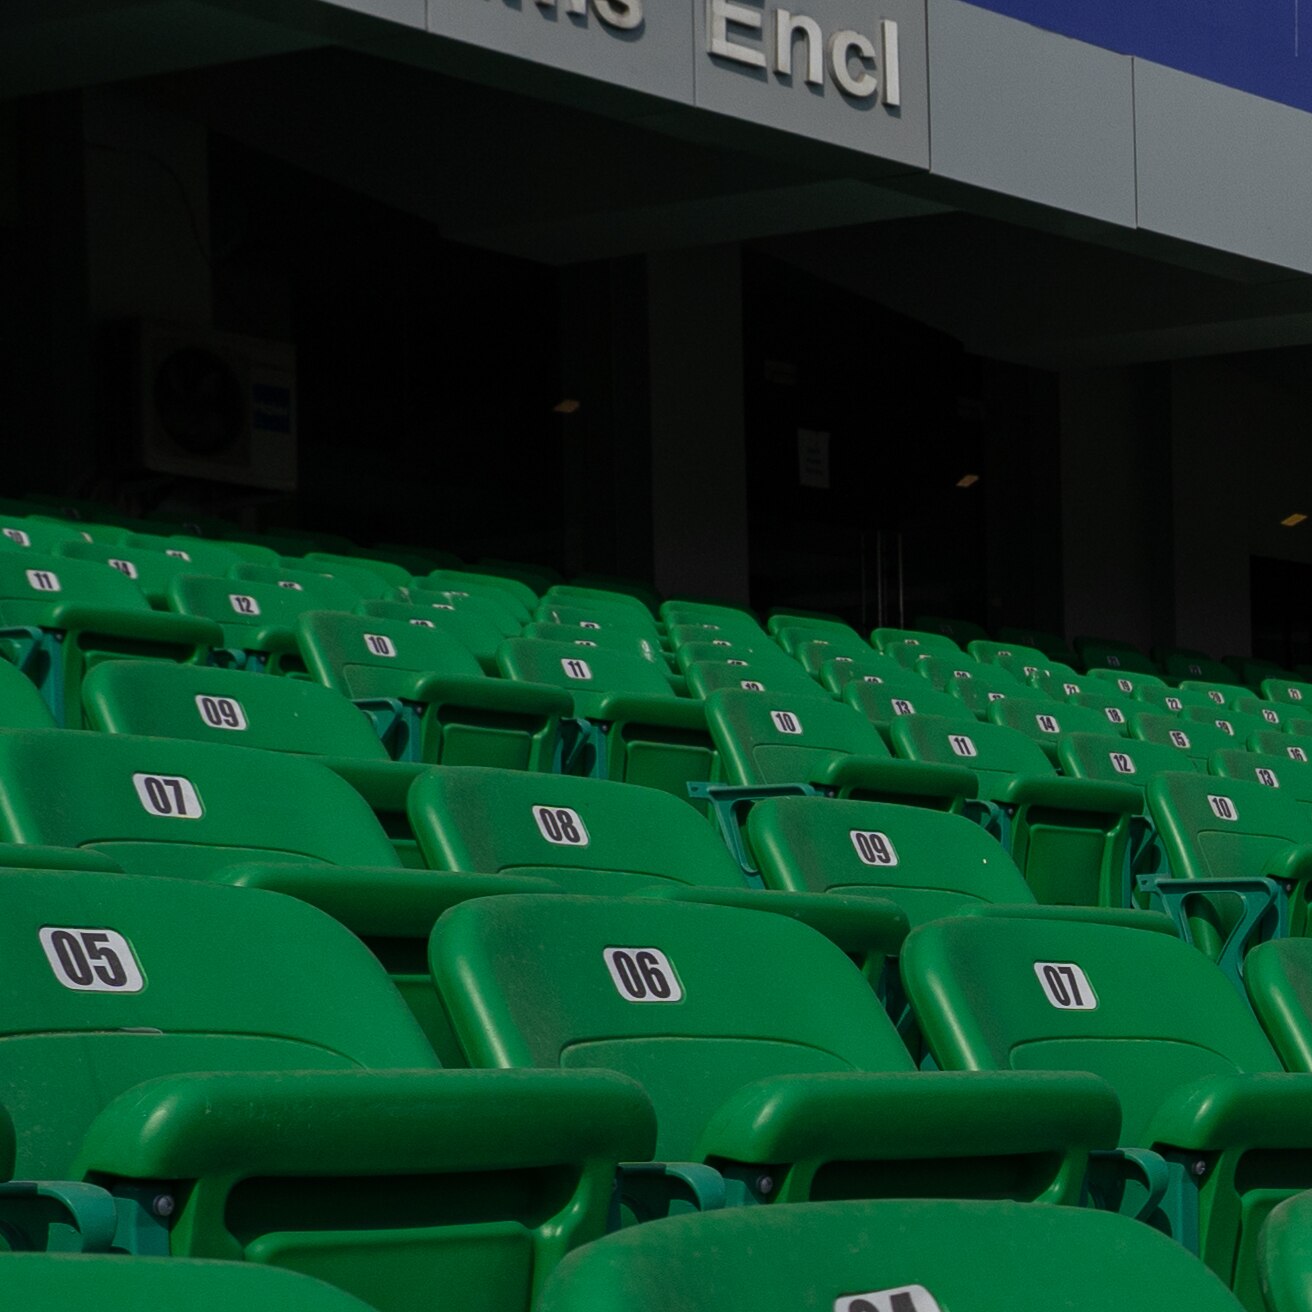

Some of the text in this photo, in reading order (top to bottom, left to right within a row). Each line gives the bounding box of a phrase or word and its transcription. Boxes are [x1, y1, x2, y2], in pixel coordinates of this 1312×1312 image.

[708, 0, 899, 106] Encl
[34, 573, 53, 589] 11
[235, 597, 254, 613] 12
[369, 636, 389, 655] 10
[568, 661, 585, 678] 11
[202, 697, 239, 727] 09
[895, 701, 911, 714] 13
[776, 713, 796, 732] 10
[1040, 716, 1055, 731] 14
[954, 737, 971, 755] 11
[1172, 732, 1186, 747] 15
[1113, 754, 1131, 772] 12
[1259, 769, 1274, 786] 13
[144, 777, 187, 815] 07
[1212, 797, 1232, 818] 10
[539, 808, 580, 843] 08
[856, 833, 891, 863] 09
[51, 930, 127, 987] 05
[612, 951, 671, 998] 06
[1043, 965, 1084, 1006] 07
